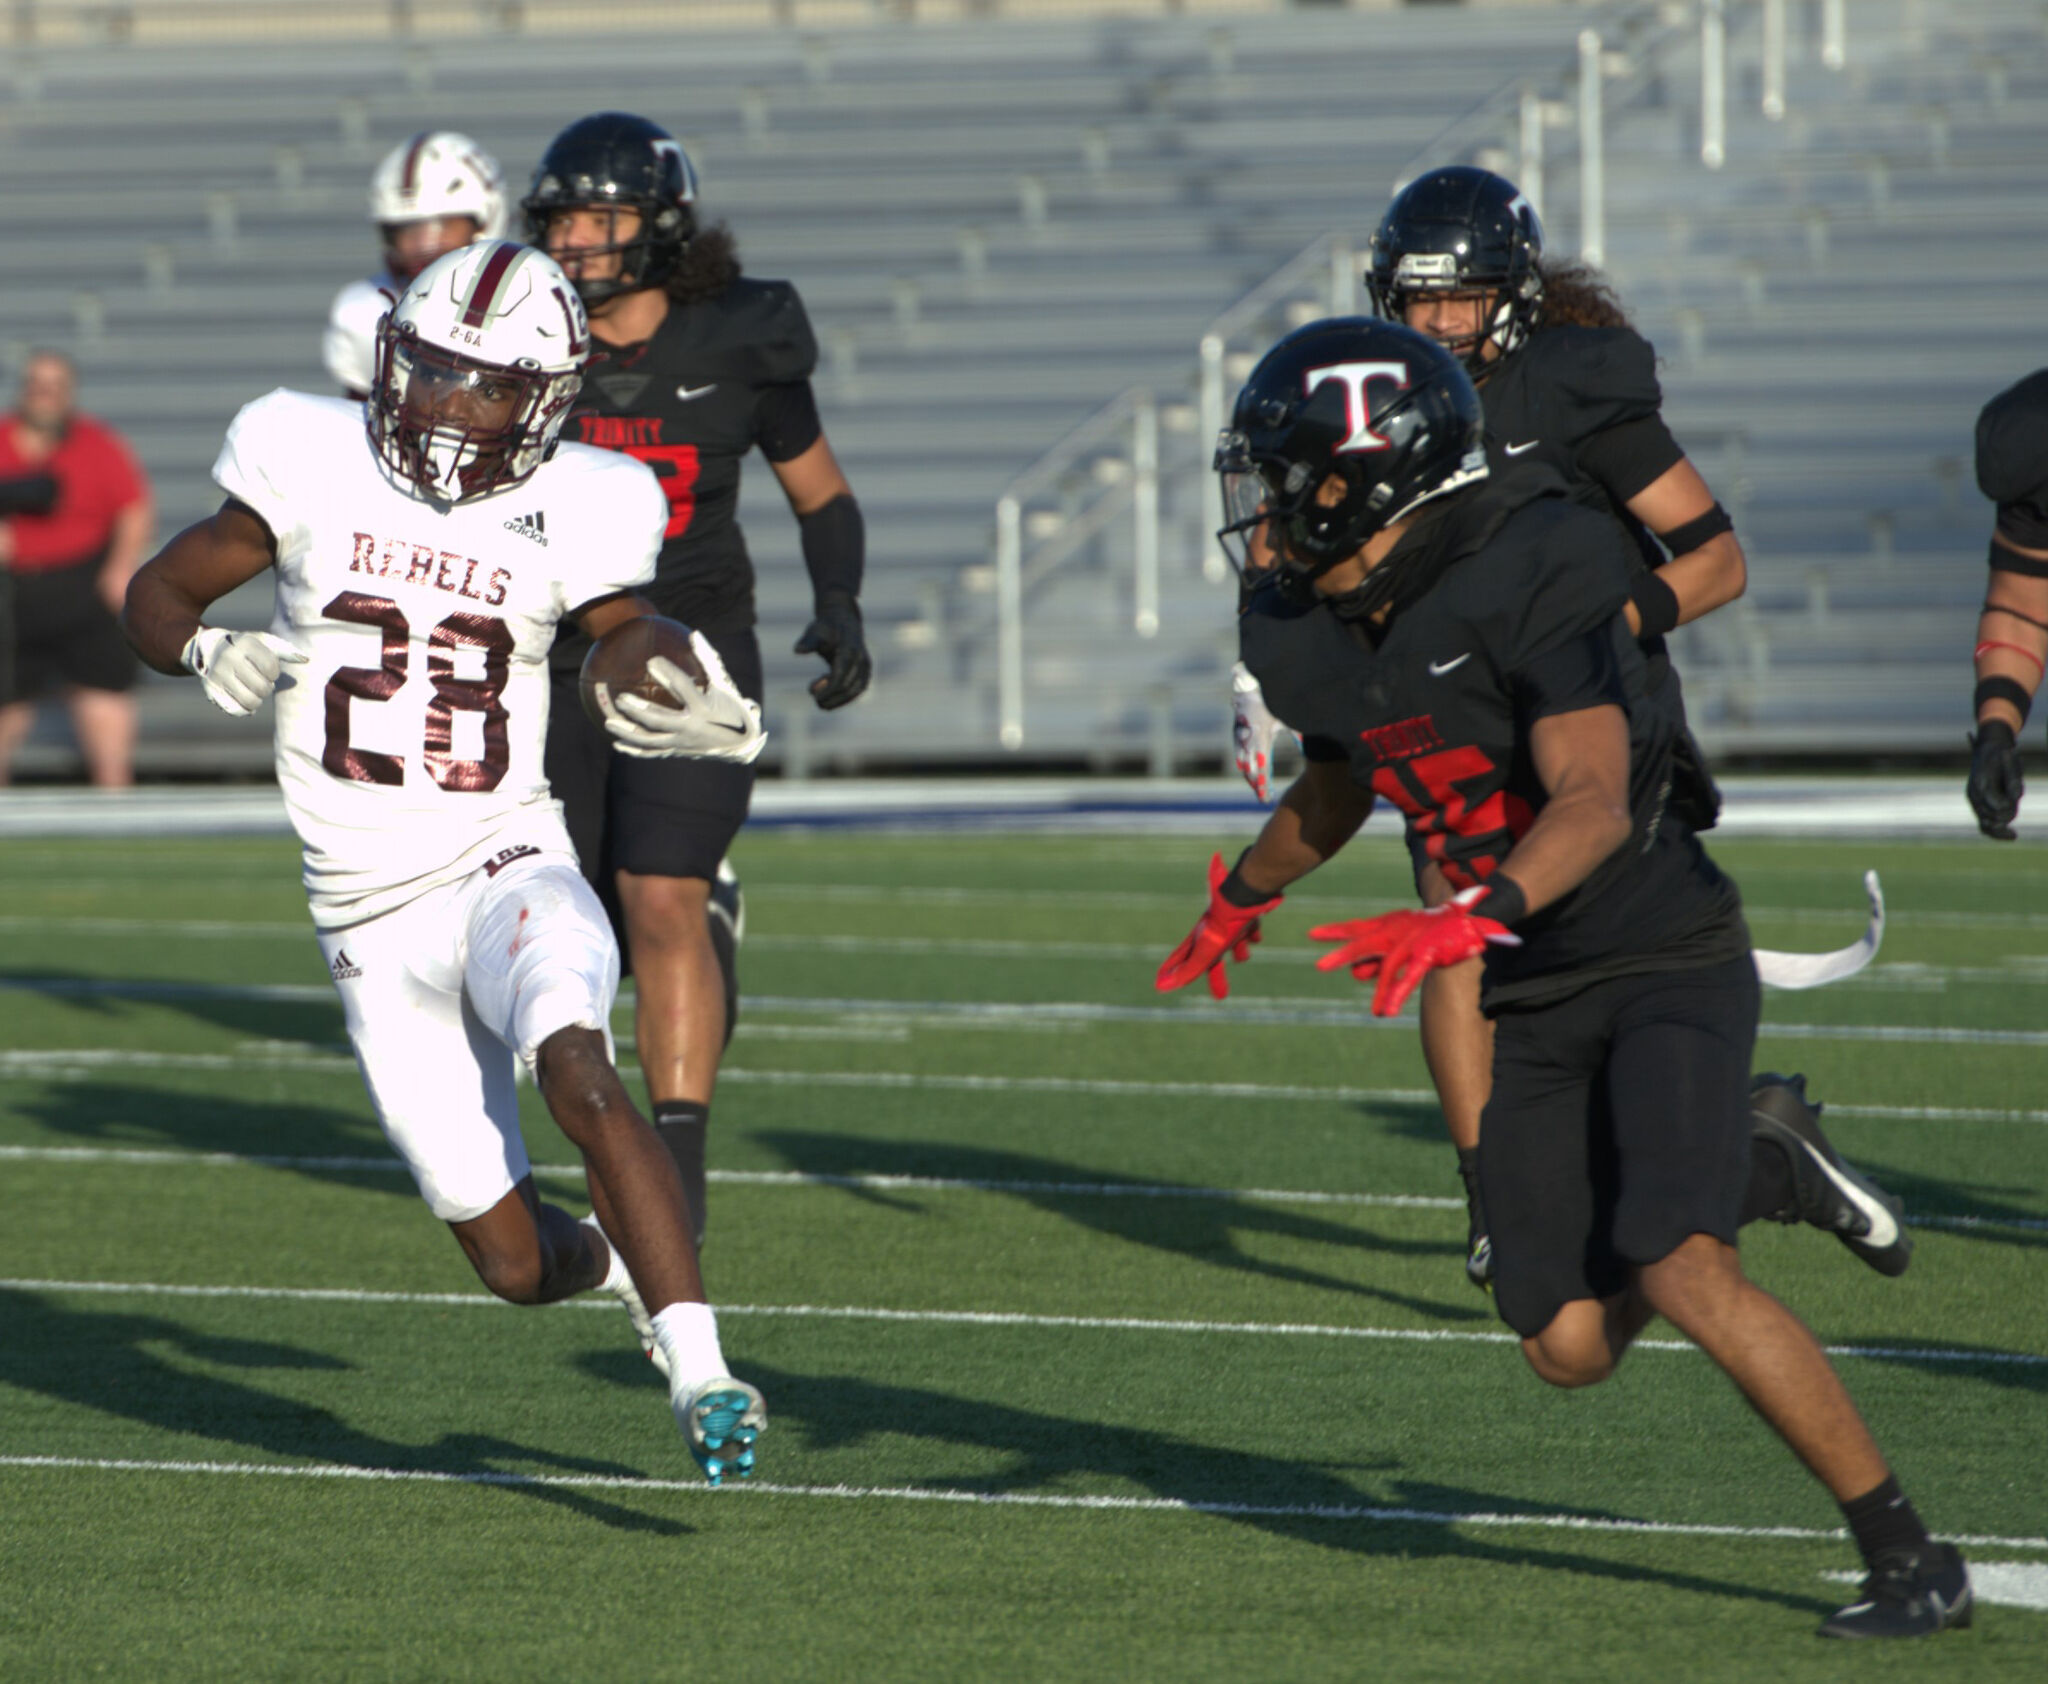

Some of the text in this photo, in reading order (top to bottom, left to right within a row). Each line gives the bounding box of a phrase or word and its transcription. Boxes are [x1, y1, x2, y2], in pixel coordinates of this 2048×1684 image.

[449, 326, 482, 347] 2-6A
[578, 417, 664, 446] TRINITY
[1305, 358, 1410, 454] T
[503, 519, 549, 547] adidas
[349, 532, 512, 606] REBELS
[321, 590, 515, 792] 28
